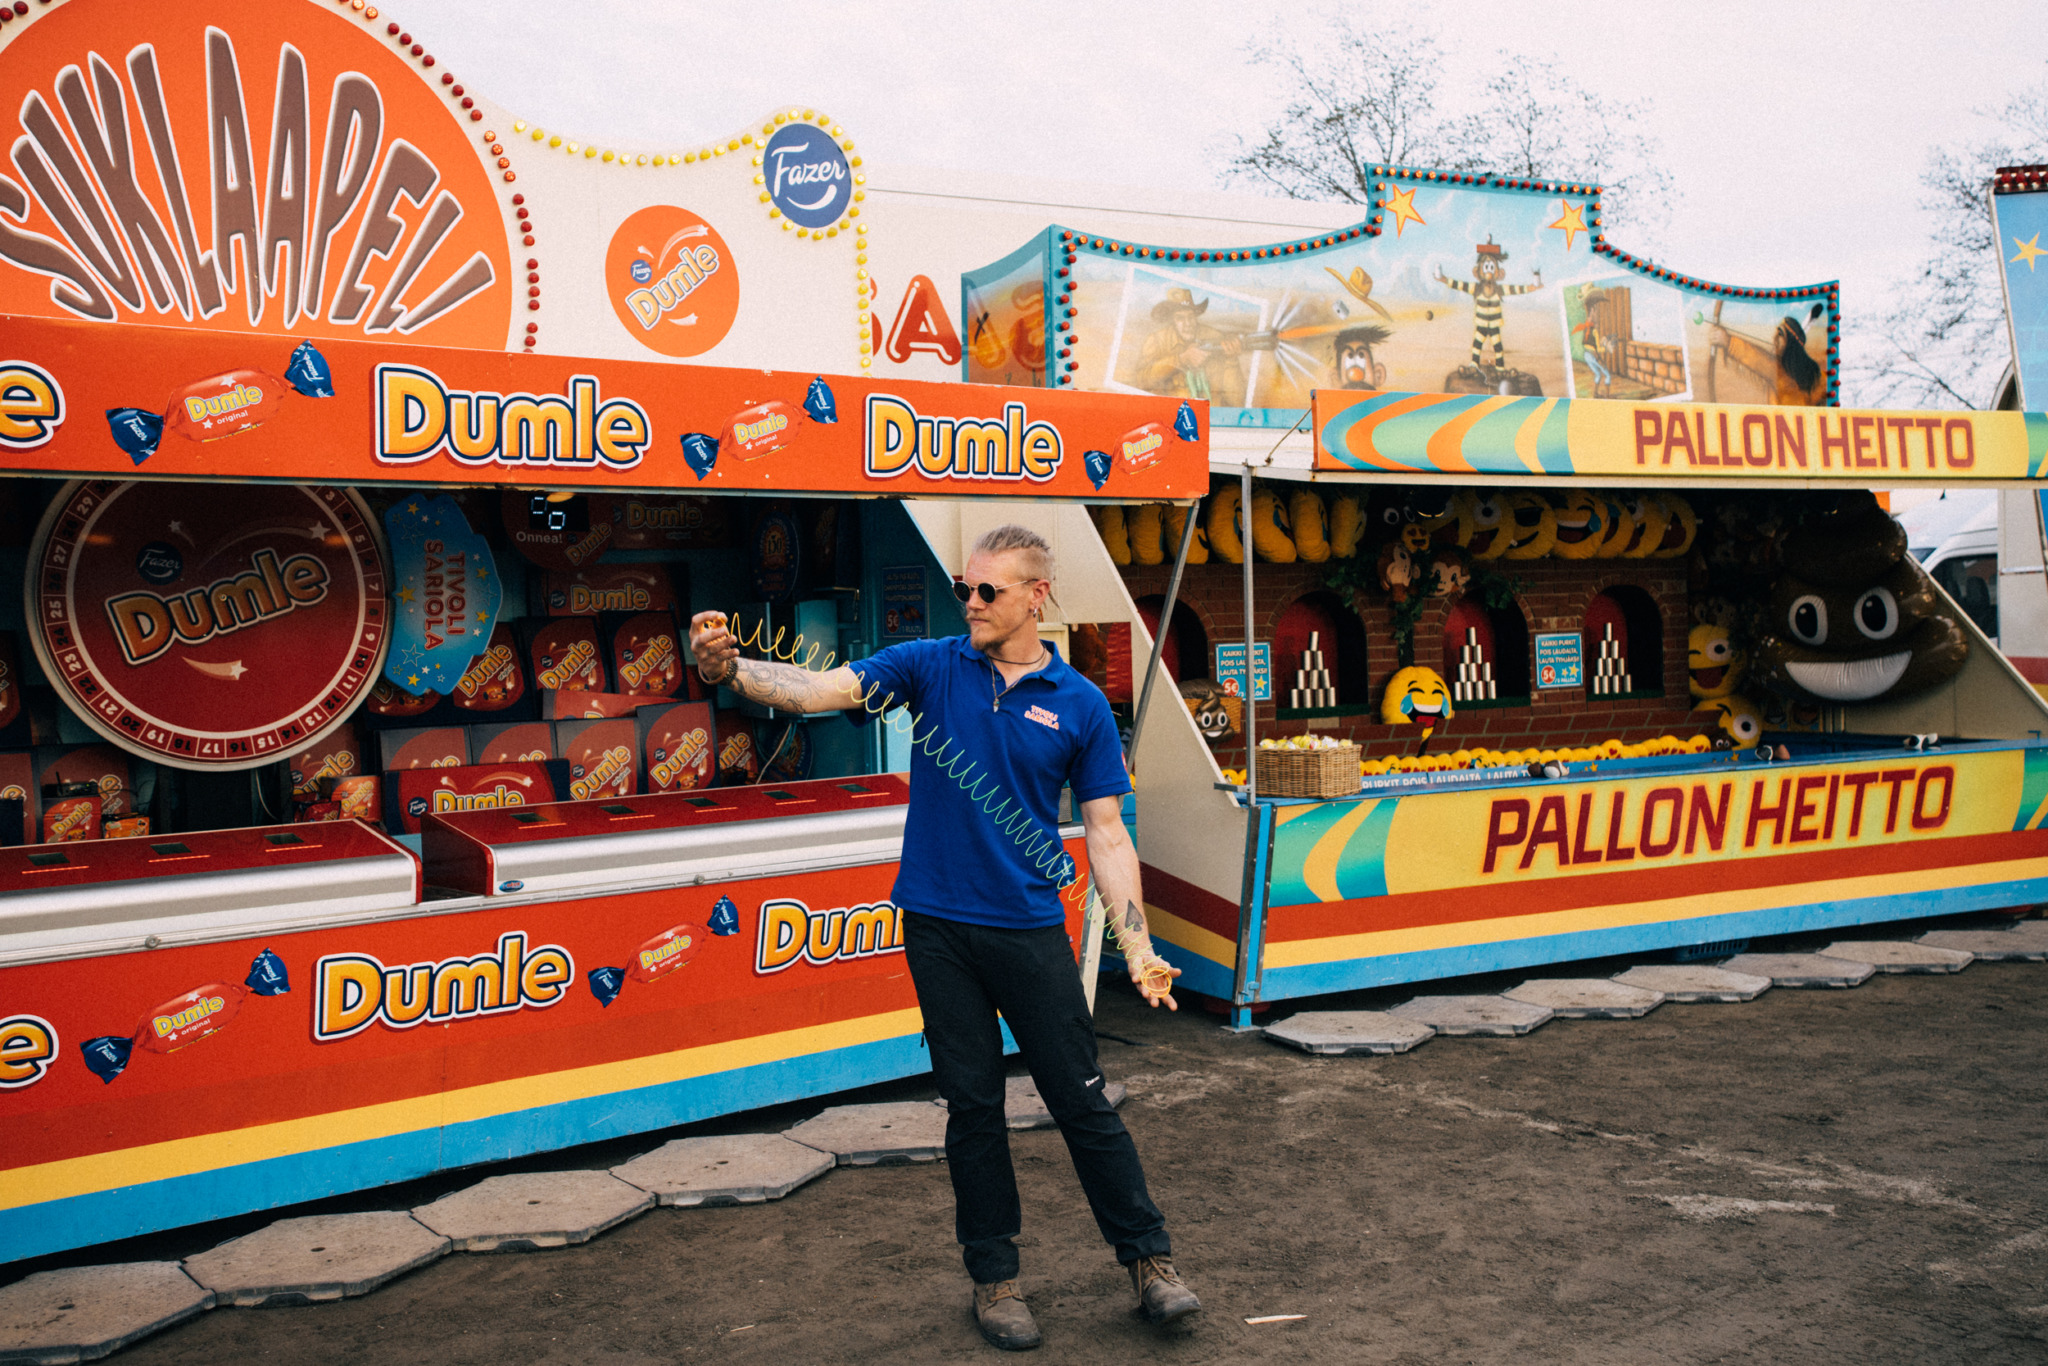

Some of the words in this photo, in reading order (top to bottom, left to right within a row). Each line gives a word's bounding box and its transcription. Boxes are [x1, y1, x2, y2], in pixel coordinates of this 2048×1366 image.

[771, 141, 846, 198] Fazer
[625, 244, 719, 331] Dumle
[185, 384, 263, 422] Dumle
[374, 362, 652, 468] Dumle
[123, 415, 147, 442] Fazer
[216, 409, 249, 425] original
[733, 413, 788, 445] Dumle
[755, 434, 778, 447] original
[865, 392, 1065, 482] Dumle
[1122, 432, 1163, 461] Dumle
[1633, 409, 1808, 468] PALLON
[1819, 414, 1975, 468] HEITTO
[77, 496, 94, 515] 29
[626, 500, 703, 529] Dumle
[515, 530, 563, 544] Onnea!
[564, 521, 613, 567] Dumle
[53, 544, 68, 565] 27
[139, 548, 181, 569] Fazer
[423, 538, 445, 652] SARIOLA
[445, 550, 467, 636] TIVOLI
[570, 582, 651, 614] Dumle
[49, 600, 63, 618] 25
[105, 547, 330, 667] Dumle
[365, 632, 375, 642] 9
[64, 653, 82, 673] 23
[456, 644, 513, 699] Dumle
[538, 641, 595, 689] Dumle
[620, 634, 674, 688] Dumle
[79, 676, 97, 695] 22
[342, 674, 358, 690] 11
[1224, 682, 1238, 693] 5€
[99, 698, 118, 716] 21
[325, 694, 341, 710] 12
[1031, 704, 1059, 723] TIVOLI
[121, 715, 141, 731] 20
[281, 725, 299, 739] 14
[305, 711, 322, 727] 13
[1024, 709, 1060, 731] SARIOLA
[146, 729, 165, 744] 19
[174, 738, 191, 750] 18
[202, 742, 220, 754] 17
[230, 741, 247, 753] 16
[257, 735, 275, 749] 15
[650, 727, 708, 788] Dumle
[570, 745, 631, 800] Dumle
[341, 780, 374, 812] Dumle
[432, 784, 525, 813] Dumle
[50, 801, 93, 837] Dumle
[1483, 782, 1733, 874] PALLON
[1744, 765, 1956, 849] HEITTO
[639, 935, 692, 970] Dumle
[659, 954, 681, 969] original
[314, 930, 576, 1041] Dumle
[152, 996, 225, 1038] Dumle
[181, 1018, 211, 1036] original
